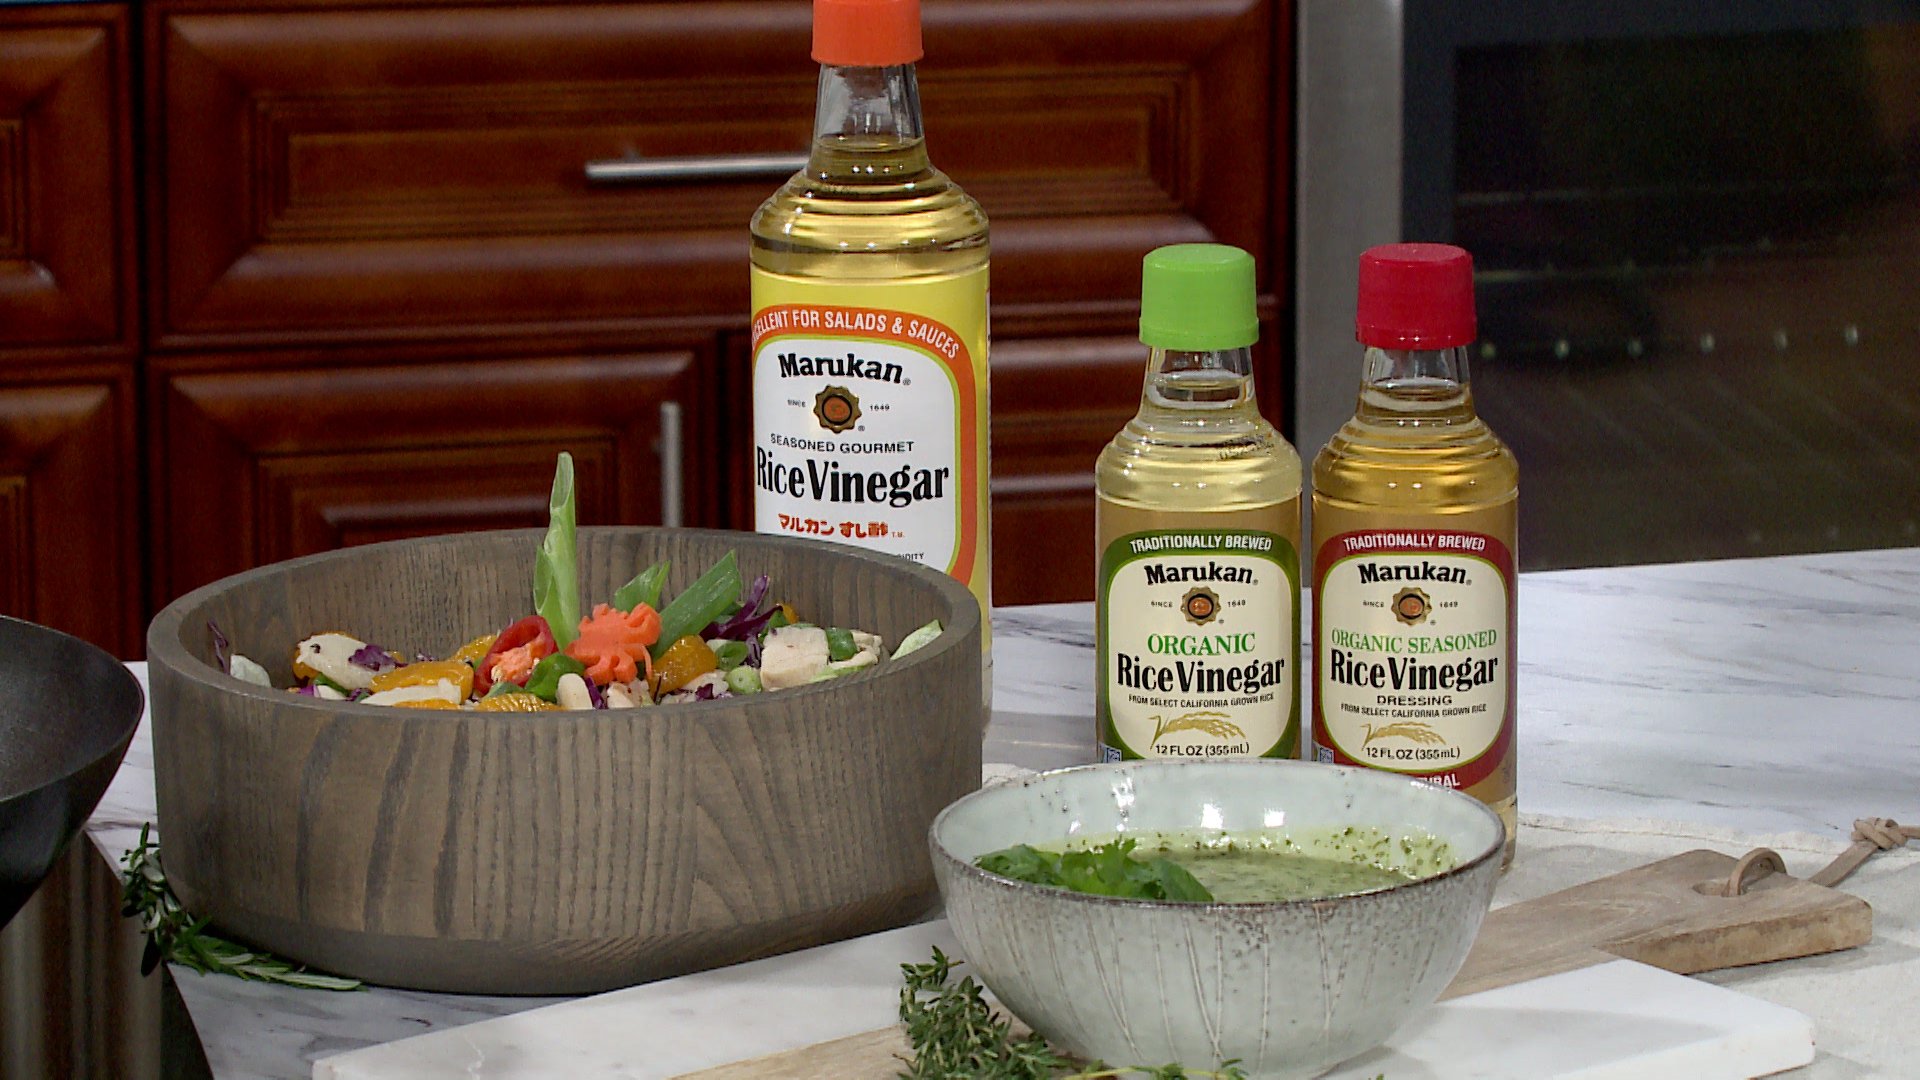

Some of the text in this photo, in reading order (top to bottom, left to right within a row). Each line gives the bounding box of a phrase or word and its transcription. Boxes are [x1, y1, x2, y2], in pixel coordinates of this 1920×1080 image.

[752, 309, 960, 360] CELLENT FOR SALADS & SAUCES
[778, 353, 903, 384] Marukan
[787, 399, 890, 412] SINCE 1649
[770, 433, 915, 454] SEASONED GOURMET
[756, 445, 949, 508] Rice Vinegar
[778, 513, 835, 536] マルカン
[1129, 535, 1272, 553] TRADITIONALLY BREWED
[1343, 533, 1486, 551] TRADITIONALLY BREWED
[1144, 561, 1253, 586] Marukan
[1357, 561, 1467, 584] Marukan
[1151, 600, 1173, 608] SINCE
[1362, 600, 1385, 608] SINCE
[1147, 633, 1256, 656] ORGANIC
[1331, 627, 1497, 654] ORGANIC SEASONED
[1117, 652, 1285, 694] Rice Vinegar
[1330, 648, 1498, 692] Rice Vinegar
[1128, 692, 1274, 708] FROM SELECT CALIFORNIA GROWN RICE
[1340, 703, 1487, 718] FROM SELECT CALIFORNIA GROWN RICE
[1376, 695, 1453, 706] DRESSING
[1155, 743, 1168, 755] 12
[1170, 745, 1185, 756] FL
[1185, 745, 1203, 756] OZ
[1366, 747, 1378, 758] 12
[1396, 749, 1413, 760] OZ
